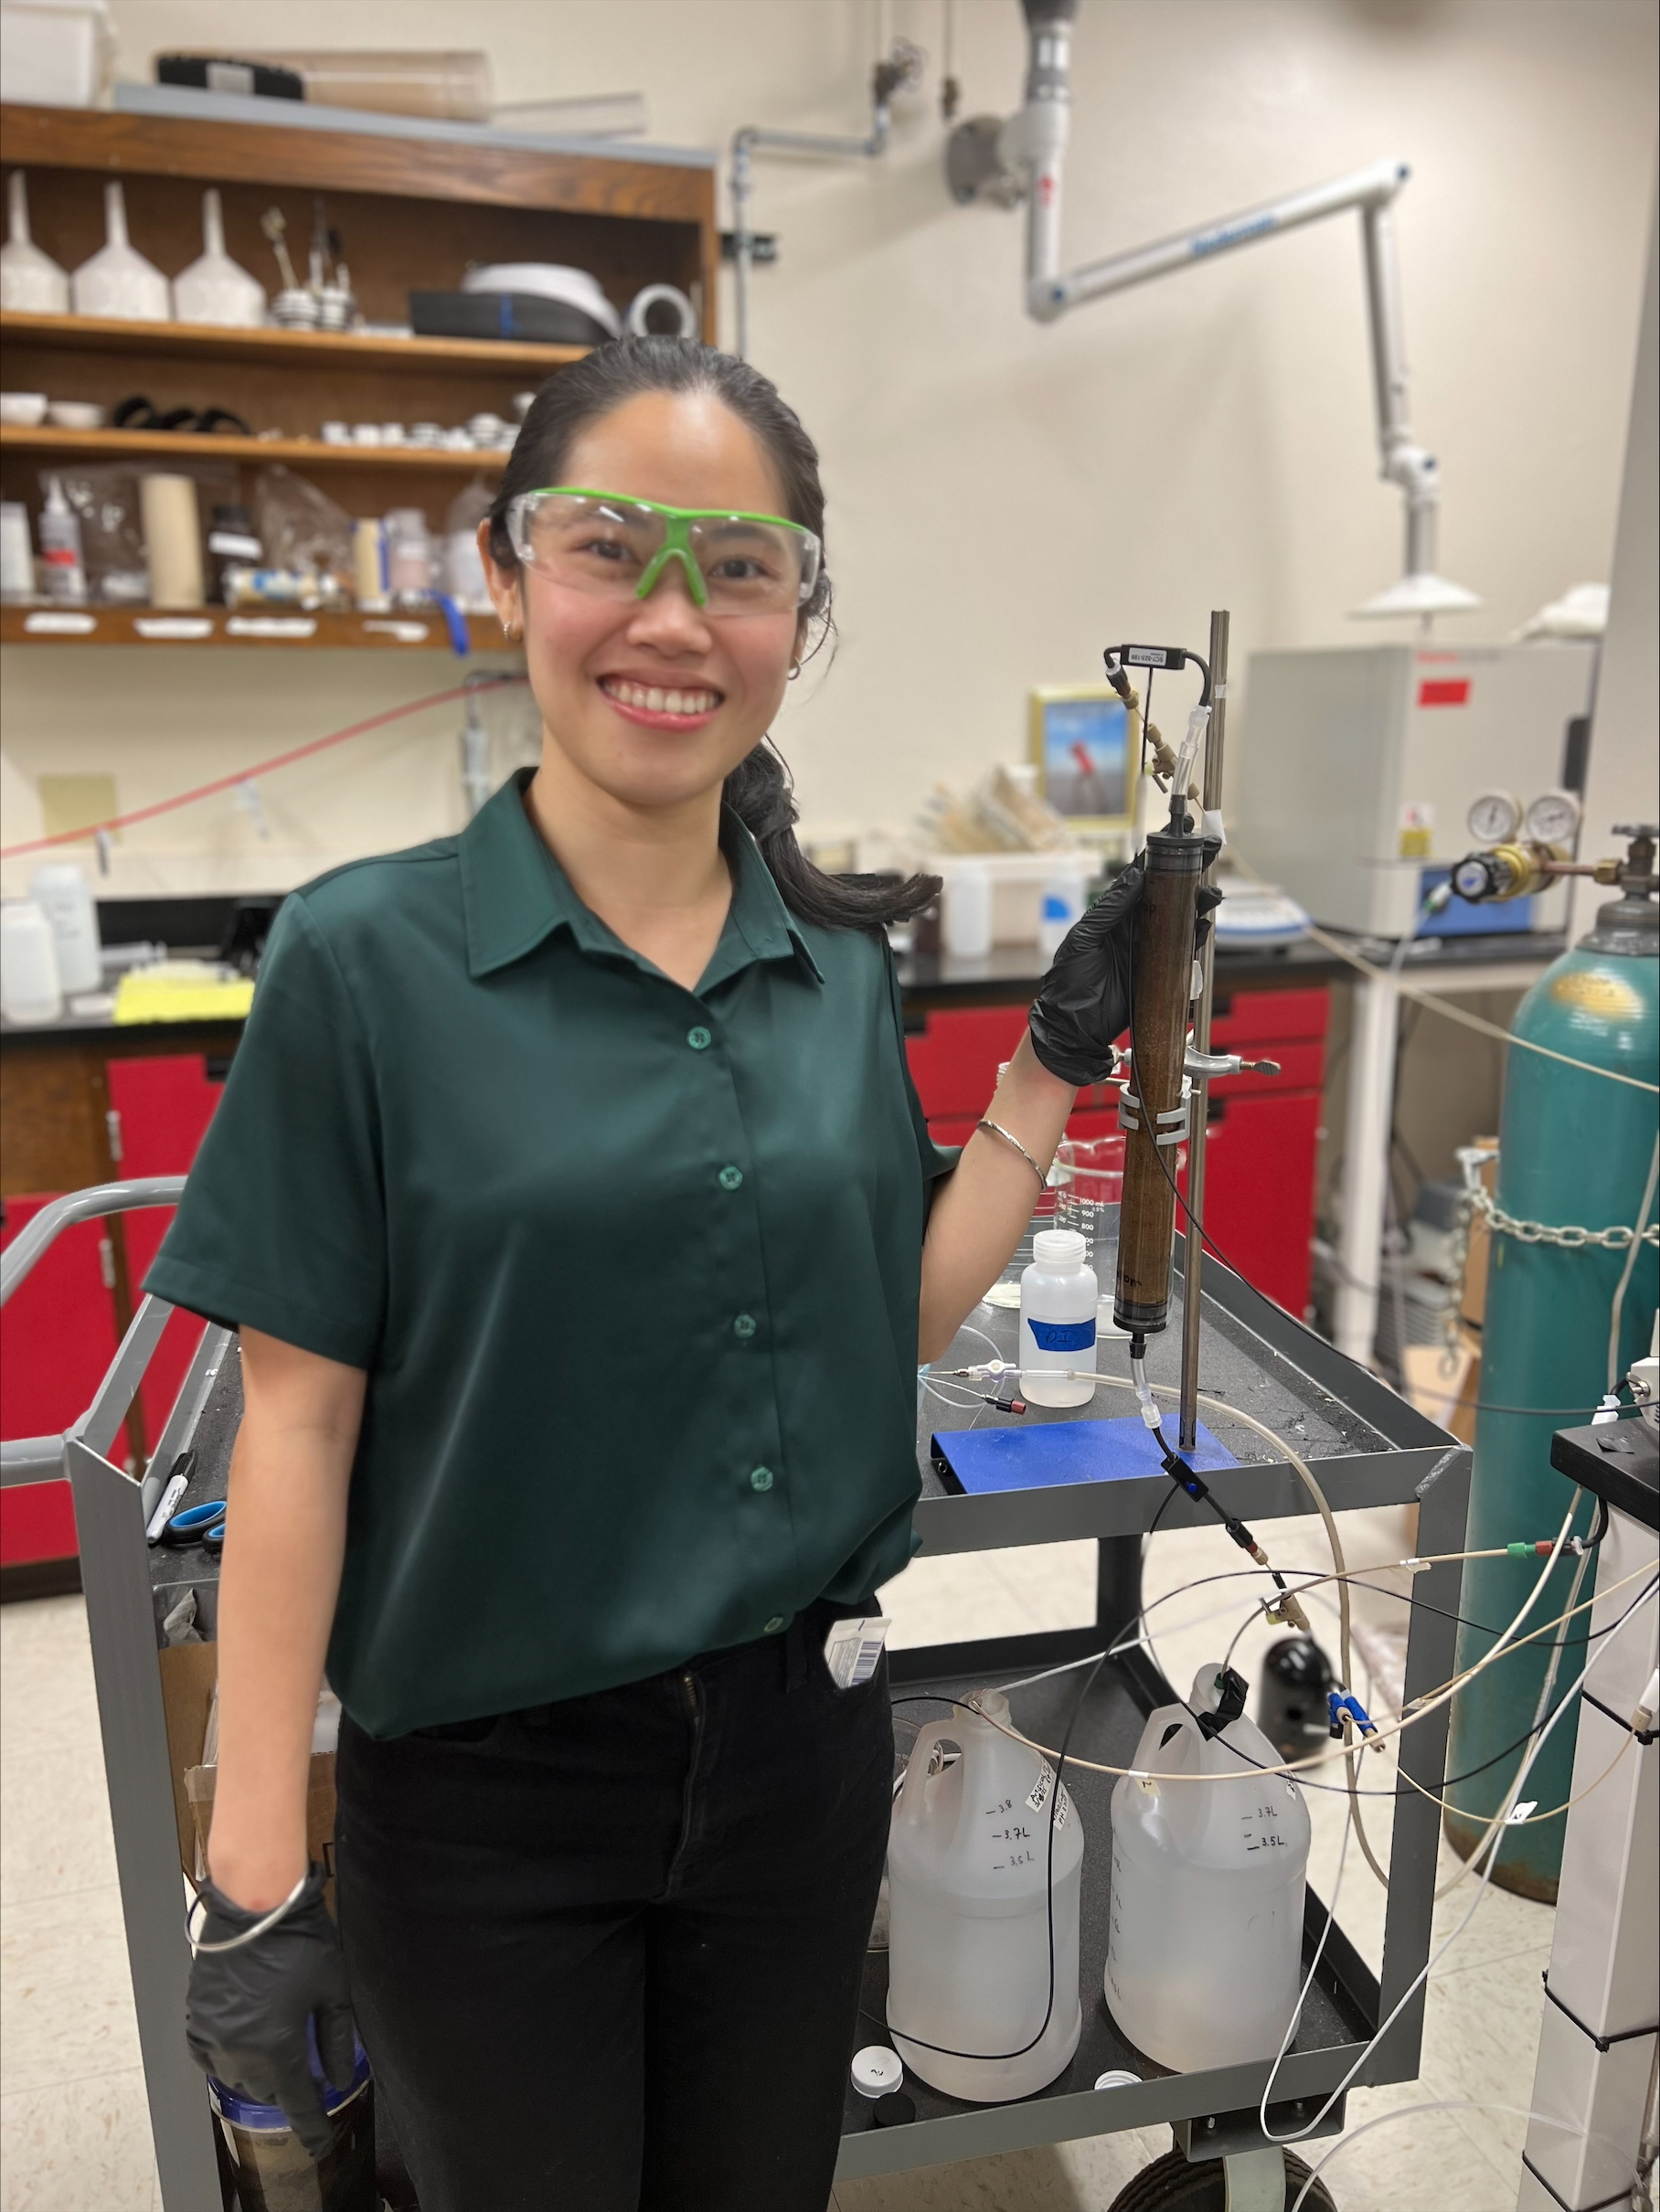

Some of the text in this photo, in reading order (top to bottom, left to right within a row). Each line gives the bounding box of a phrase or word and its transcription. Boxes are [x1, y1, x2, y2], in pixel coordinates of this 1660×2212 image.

[1080, 1197, 1094, 1206] 1000
[1081, 1209, 1094, 1218] 900
[998, 1799, 1013, 1813] 3.8
[1258, 1805, 1278, 1818] 3.7L
[1005, 1827, 1031, 1840] 3.7L
[1261, 1834, 1284, 1846] 3.5L
